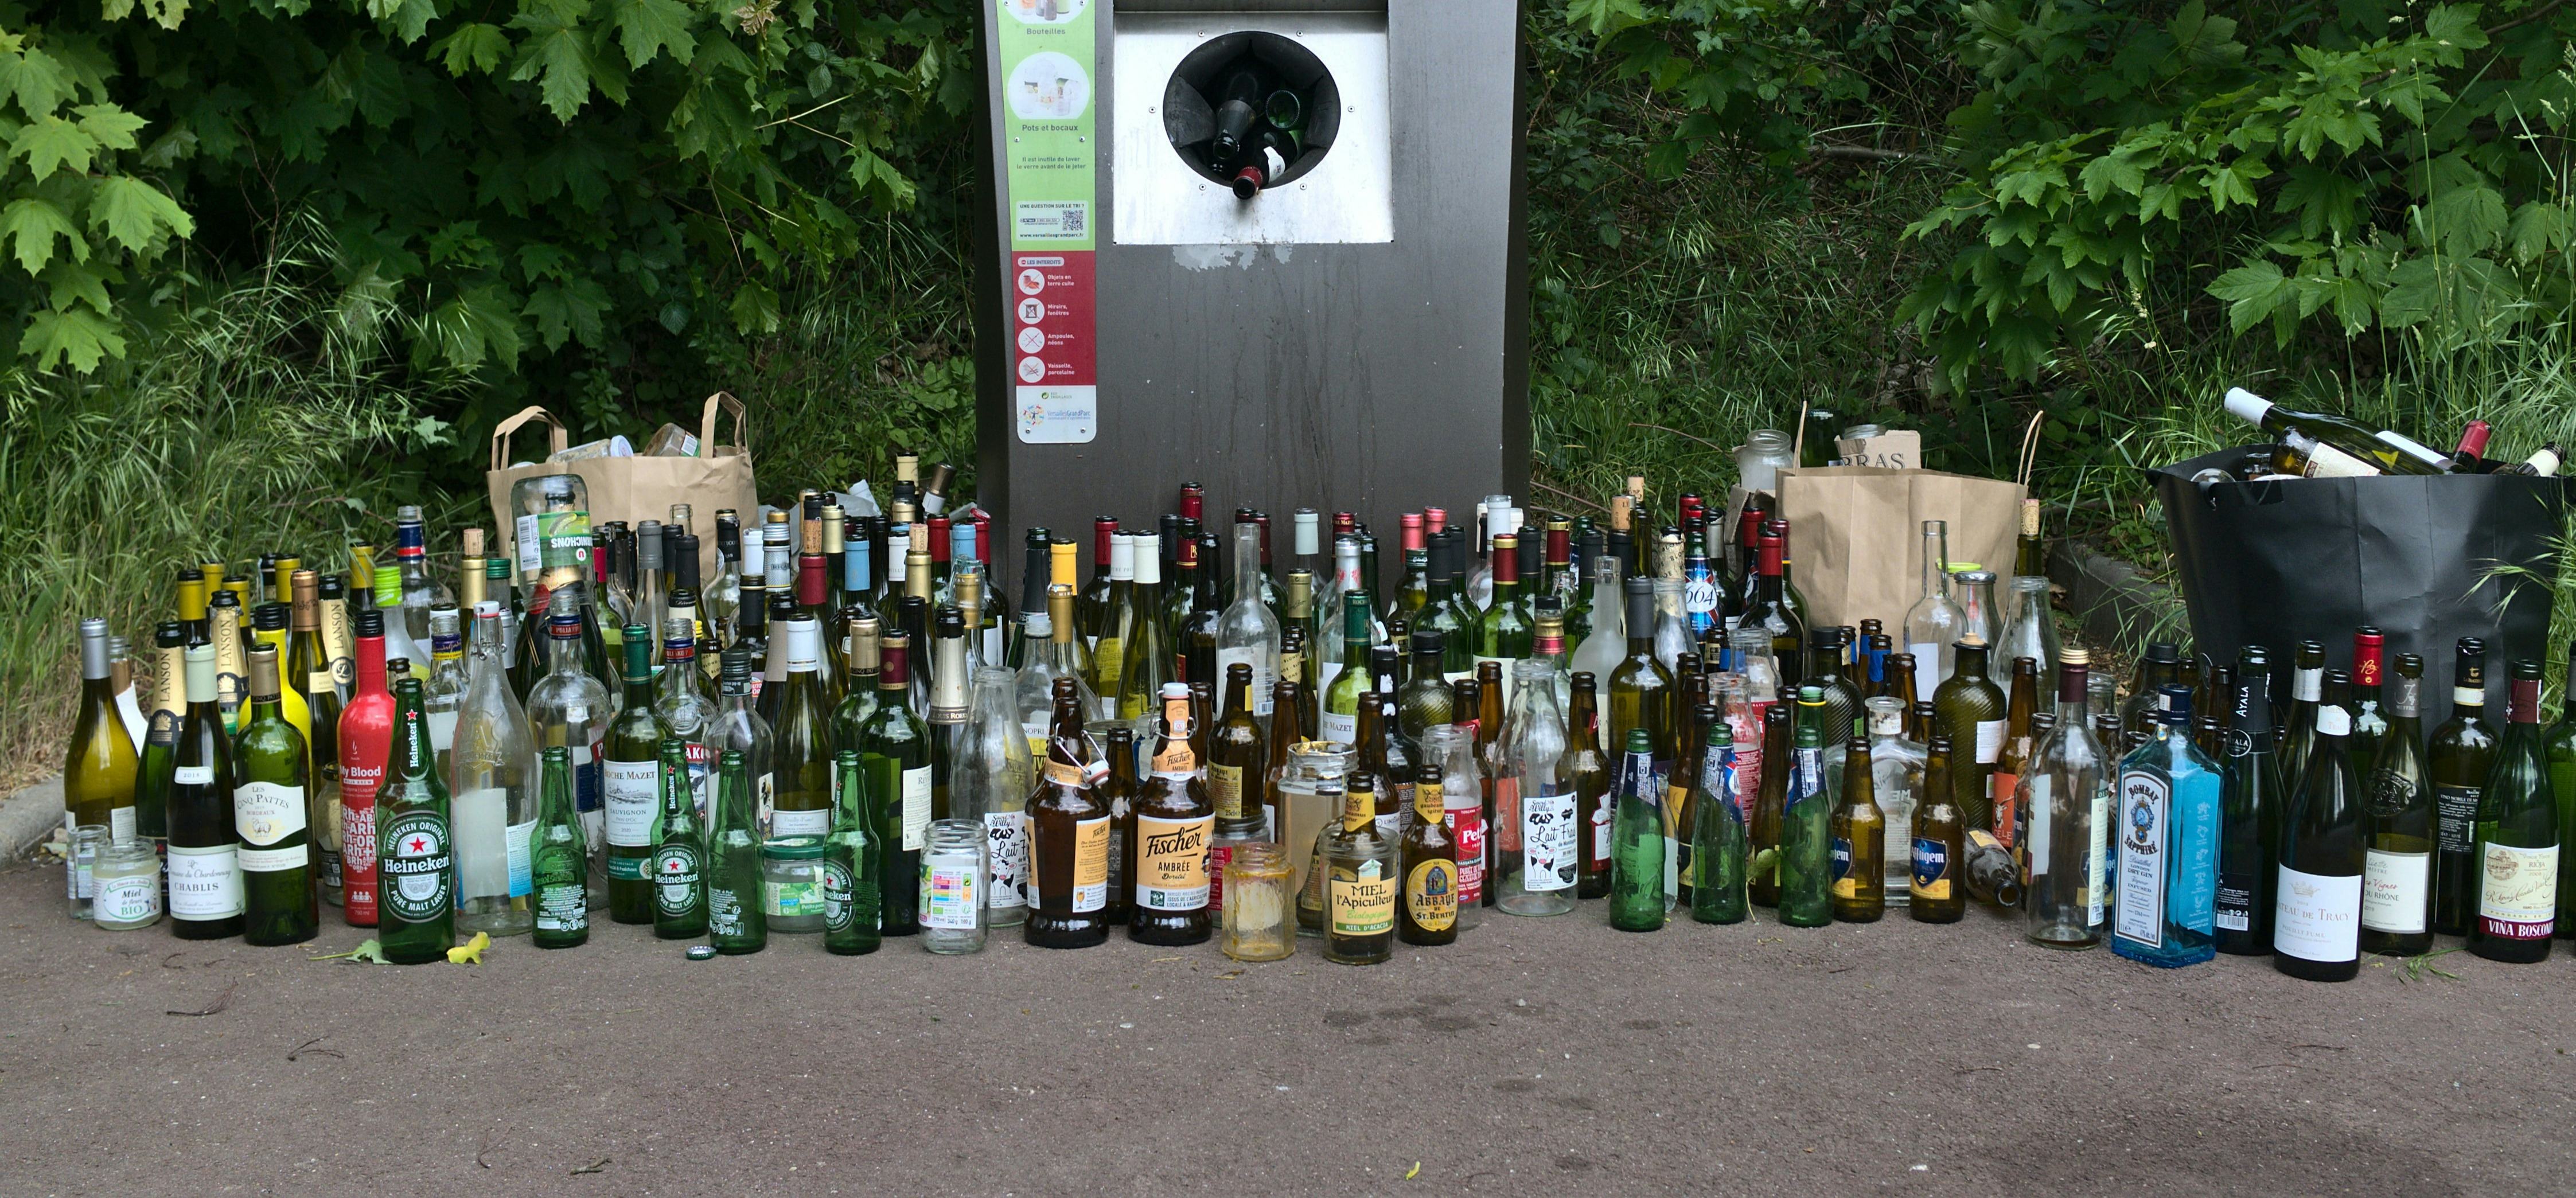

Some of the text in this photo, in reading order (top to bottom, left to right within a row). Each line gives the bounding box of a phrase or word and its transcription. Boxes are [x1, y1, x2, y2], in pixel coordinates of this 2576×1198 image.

[1685, 588, 1716, 606] 664
[331, 604, 344, 649] LANSON
[220, 620, 232, 666] LANSON
[159, 653, 170, 702] LANSON
[2236, 686, 2249, 717] AYALA
[1330, 721, 1353, 732] MAZET
[410, 721, 418, 768] Heineken
[1167, 751, 1191, 767] Fischer
[350, 766, 381, 778] Blood
[627, 771, 656, 780] MAZET
[237, 793, 290, 810] CINQ PATTES
[2127, 784, 2160, 805] BOMBAY
[388, 822, 416, 850] HEINEKEN
[420, 821, 446, 845] ORIGINAL
[1146, 824, 1203, 858] Fischer
[1530, 825, 1560, 844] Lait
[991, 841, 1018, 859] Lait
[2124, 834, 2158, 855] SAPPHIRE
[657, 851, 695, 868] HEINEKEN ORIGINAL
[1911, 846, 1944, 863] Affligem
[384, 854, 450, 873] Heineken
[1158, 860, 1190, 872] AMBRÉE
[655, 873, 699, 884] Heineken
[2127, 868, 2153, 879] DRY GIN
[122, 888, 142, 899] Miel
[174, 882, 219, 892] CHABLIS
[1351, 884, 1387, 896] MIEL
[2127, 883, 2152, 893] INFUSED
[128, 898, 142, 907] fleurs
[391, 889, 407, 908] PURE
[408, 902, 429, 911] MALT
[431, 884, 447, 907] LAGER
[659, 893, 669, 908] PURE
[684, 892, 696, 907] LAGER
[824, 891, 852, 902] neken
[1336, 893, 1393, 910] l'Apiculteur
[1416, 893, 1455, 907] ABBAYE
[2374, 891, 2399, 902] RHÔNE
[120, 905, 142, 916] BIO
[835, 911, 847, 922] LAGER
[1346, 908, 1388, 922] Biologique
[2318, 908, 2350, 921] TRACY
[1346, 921, 1389, 932] MIEL D'ACACIA
[2488, 919, 2554, 937] VIÑA BOSCONI
